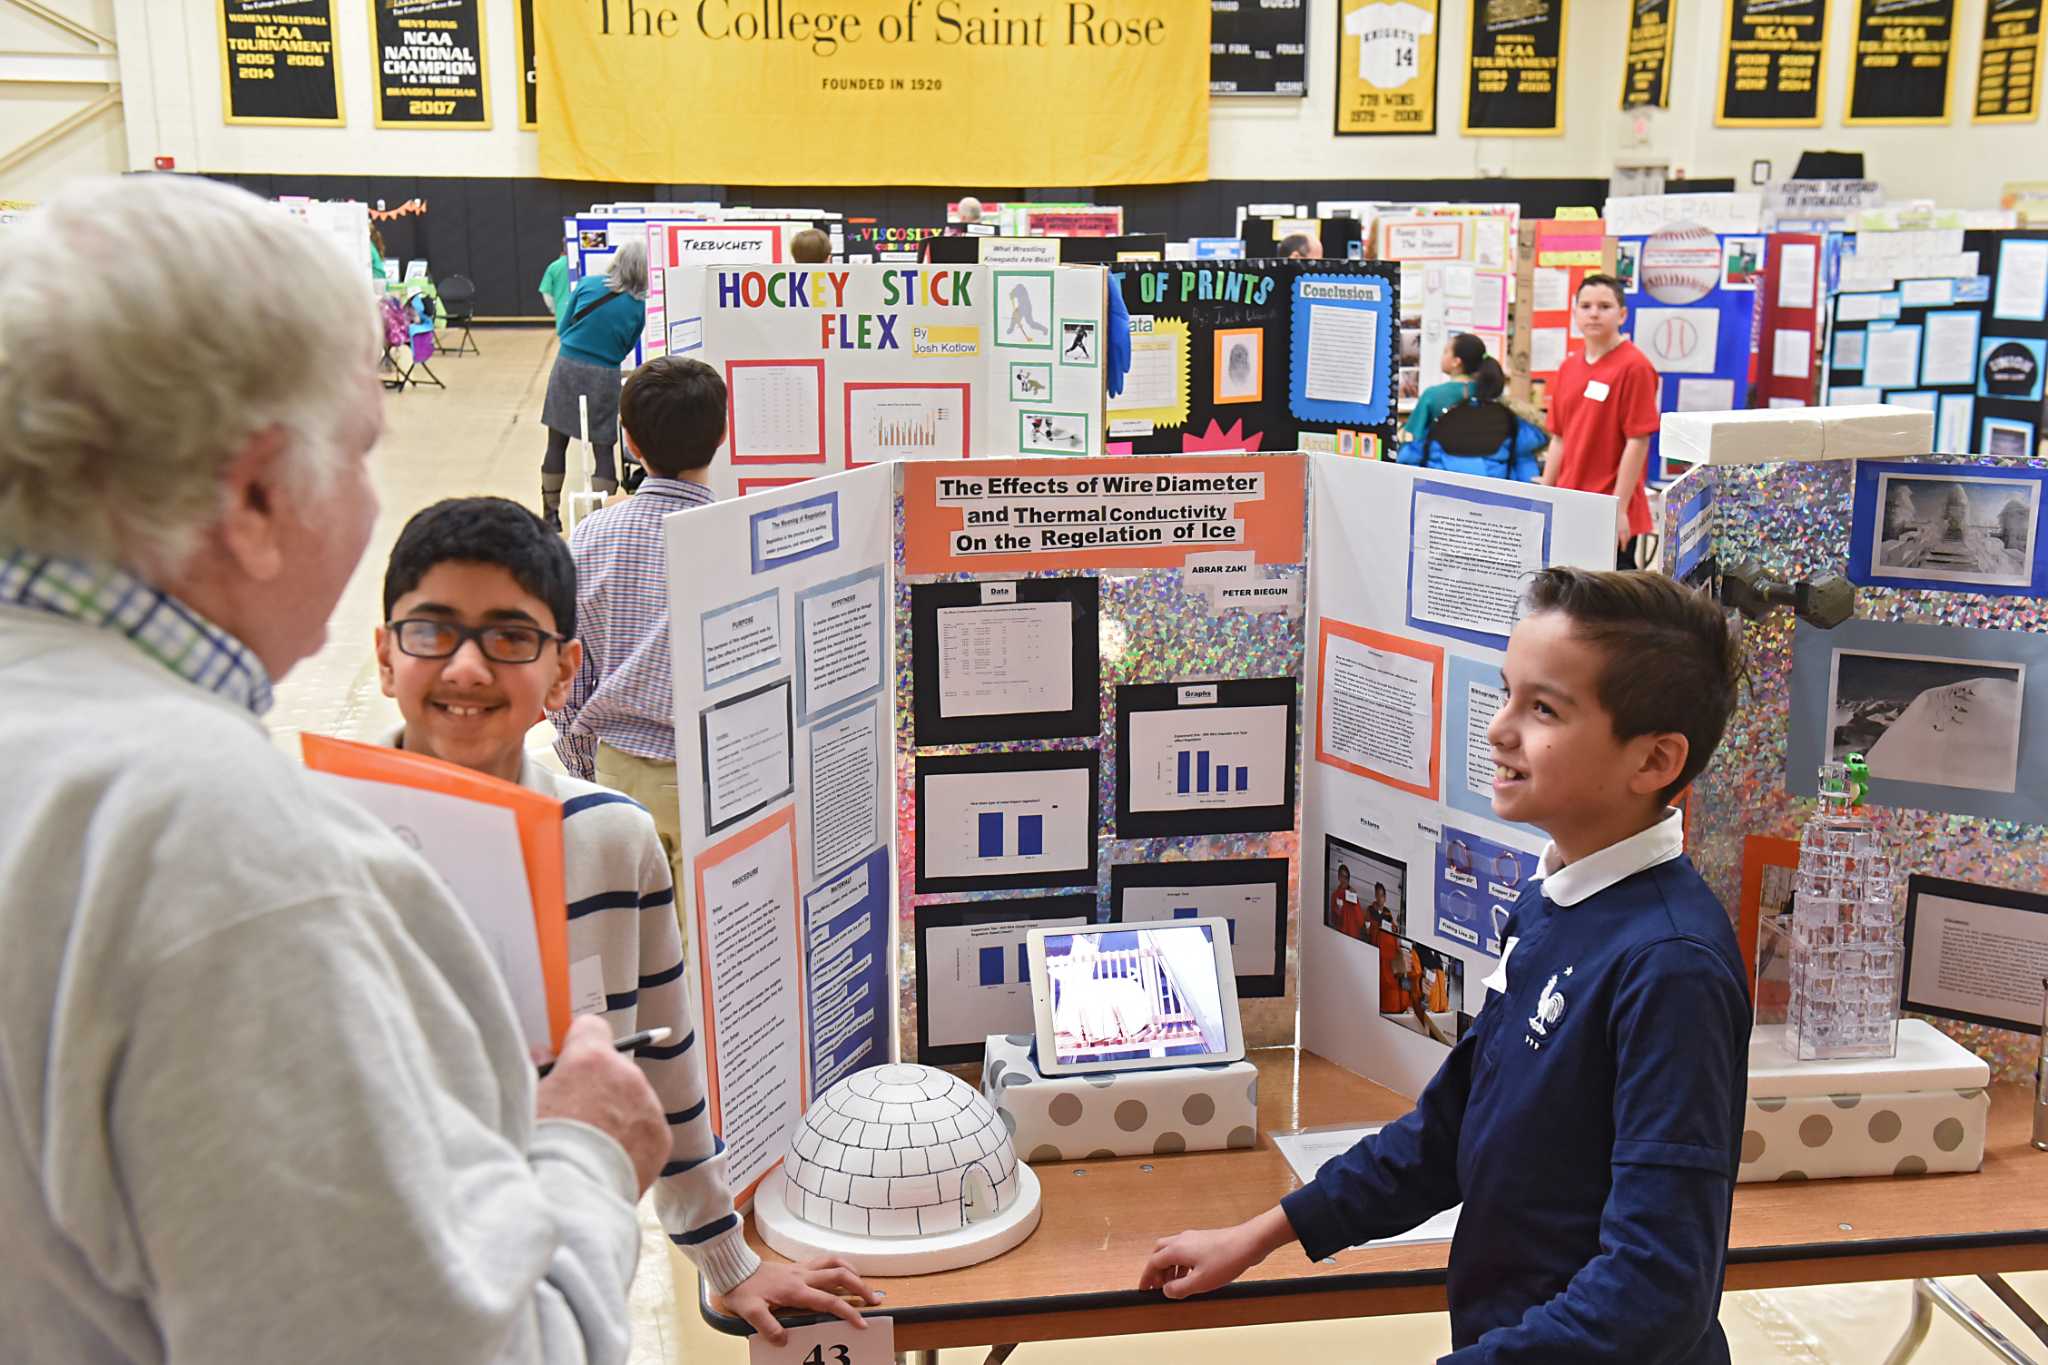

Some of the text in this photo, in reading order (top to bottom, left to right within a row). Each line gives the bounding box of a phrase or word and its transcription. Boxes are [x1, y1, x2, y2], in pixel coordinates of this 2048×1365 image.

[255, 25, 303, 40] NCAA
[598, 0, 1165, 57] The College of Saint Rose
[228, 38, 331, 53] TOURNAMENT
[403, 31, 453, 46] NCAA
[237, 53, 325, 67] 2005 2006
[385, 46, 474, 61] NATIONAL
[1396, 48, 1412, 66] 14
[239, 67, 275, 79] 2014
[384, 61, 477, 75] CHAMPION
[823, 78, 942, 90] FOUNDED IN 1920
[409, 101, 456, 115] 2007
[861, 227, 942, 241] VISCOSITY
[683, 239, 762, 251] TREBUCHETS
[719, 270, 973, 308] HOCKEY STICK
[1140, 272, 1169, 303] OF
[1181, 269, 1275, 305] PRINTS
[1303, 283, 1374, 300] Conclusion
[821, 314, 899, 350] FLEX
[914, 327, 927, 339] By
[1128, 318, 1153, 333] ata
[914, 343, 938, 353] Josh
[940, 475, 1258, 496] The Effects of Wire Diameter
[967, 505, 1227, 523] and Thermal Conductivity
[956, 523, 1236, 551] On the Regelation of Ice
[1192, 565, 1246, 574] ABRAR ZAKI
[1223, 588, 1288, 597] PETER BIEGUN
[803, 1344, 850, 1365] 43
